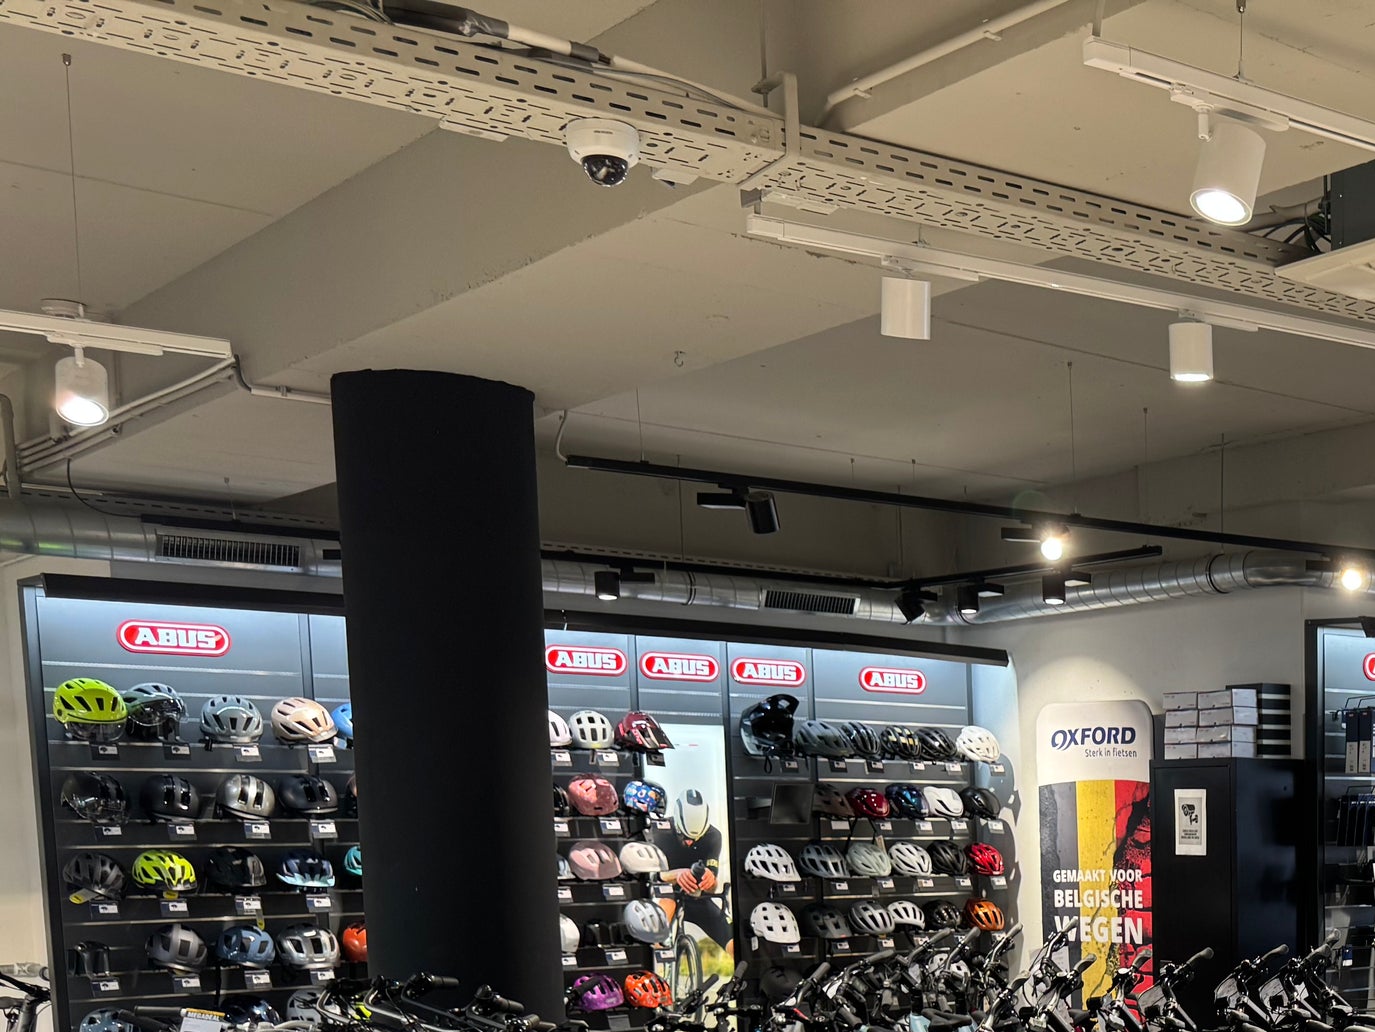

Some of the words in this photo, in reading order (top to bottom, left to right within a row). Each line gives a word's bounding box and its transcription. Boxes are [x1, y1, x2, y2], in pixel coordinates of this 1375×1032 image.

[135, 626, 217, 649] ABUS
[555, 651, 617, 670] ABUS
[652, 657, 710, 676] ABUS
[742, 662, 797, 681] ABUS
[870, 671, 919, 689] ABUS
[1051, 727, 1136, 751] OXFORD
[1084, 748, 1103, 758] Sterk
[1104, 747, 1111, 757] in
[1112, 747, 1138, 758] fietsen
[1053, 869, 1106, 883] GEMAAKT
[1110, 868, 1143, 883] VOOR
[1054, 889, 1144, 909] BELGISCHE
